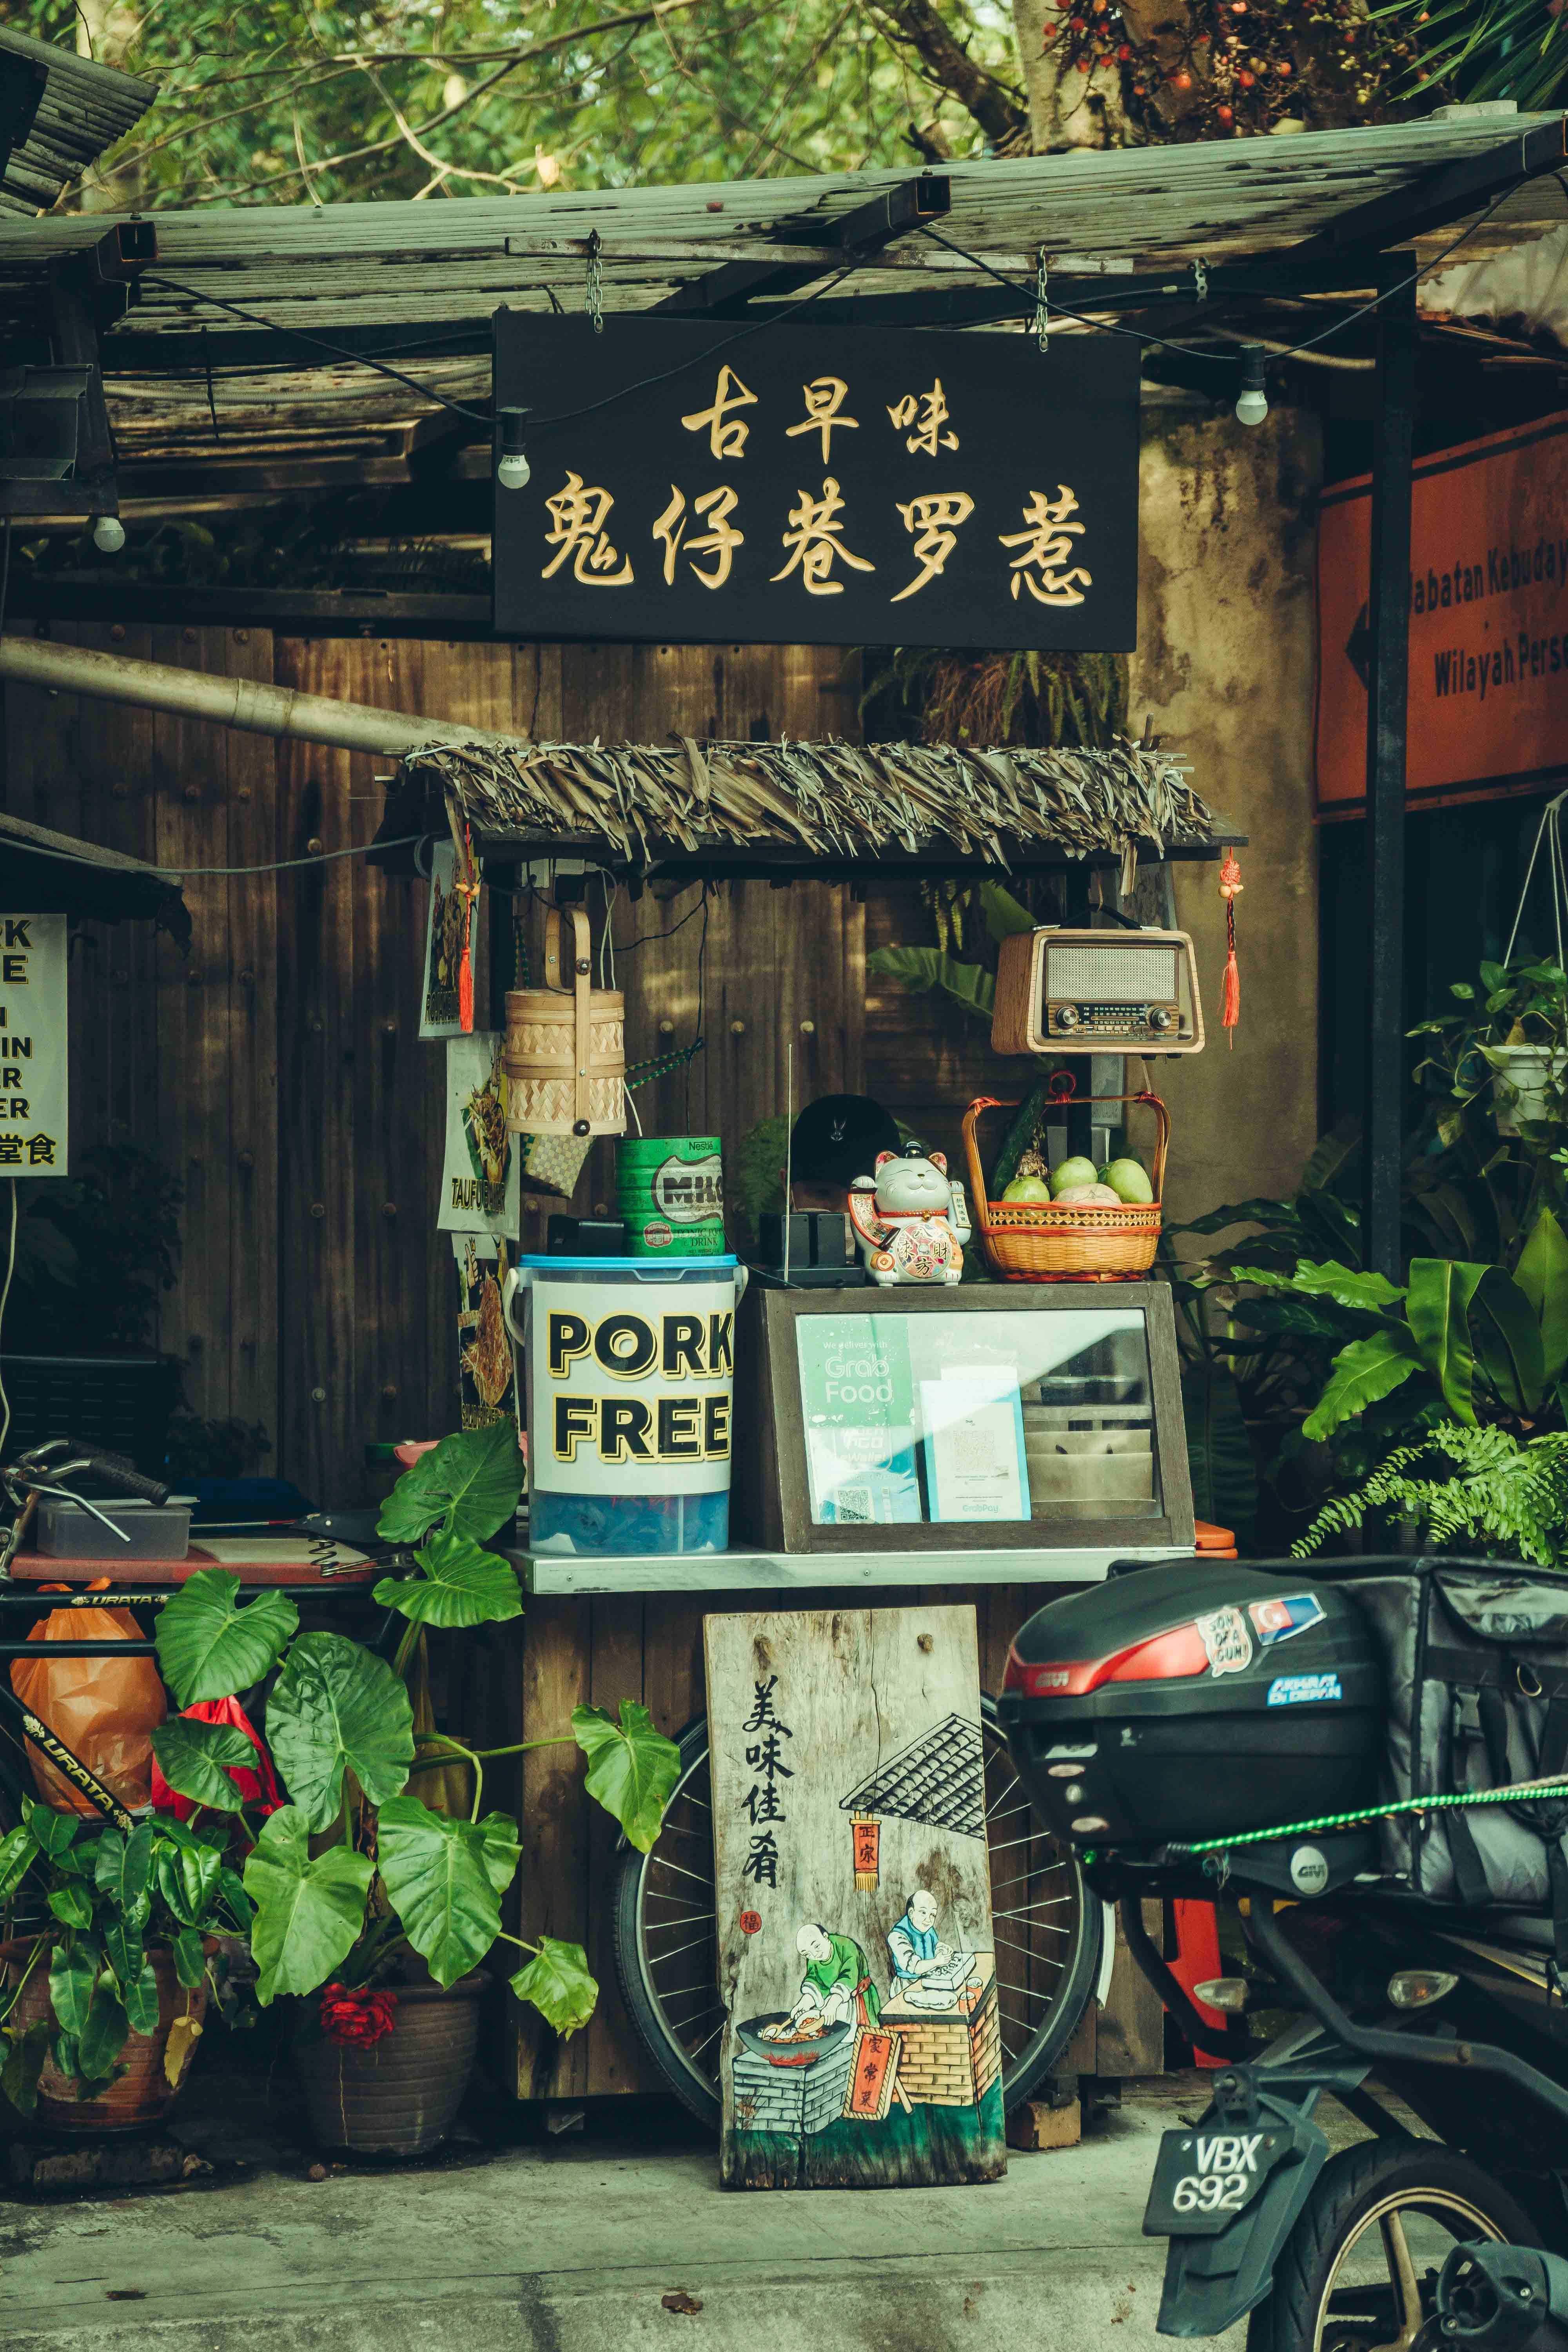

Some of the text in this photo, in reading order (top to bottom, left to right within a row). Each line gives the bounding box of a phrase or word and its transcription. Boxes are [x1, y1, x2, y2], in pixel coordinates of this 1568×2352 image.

[682, 365, 959, 464] 古早味
[542, 470, 1092, 605] 鬼仔巷罗惹
[1434, 638, 1514, 702] Wilayah
[0, 919, 34, 949] K
[451, 1176, 483, 1210] TAUFU
[691, 1237, 718, 1247] DRINK
[548, 1310, 733, 1380] PORK
[825, 1354, 889, 1378] Grab
[825, 1379, 893, 1403] Food
[553, 1393, 731, 1463] FREE
[962, 1504, 999, 1513] GrabPay
[92, 1595, 152, 1605] URATA
[1035, 1671, 1069, 1688] GIVI
[43, 1738, 114, 1811] URATA
[741, 1675, 796, 1889] 美味佳肴
[859, 1826, 877, 1863] 正宗
[1298, 1865, 1325, 1878] GIVI
[859, 2034, 882, 2109] 家常菜
[1197, 2133, 1264, 2174] VBX
[1173, 2173, 1249, 2212] 692
